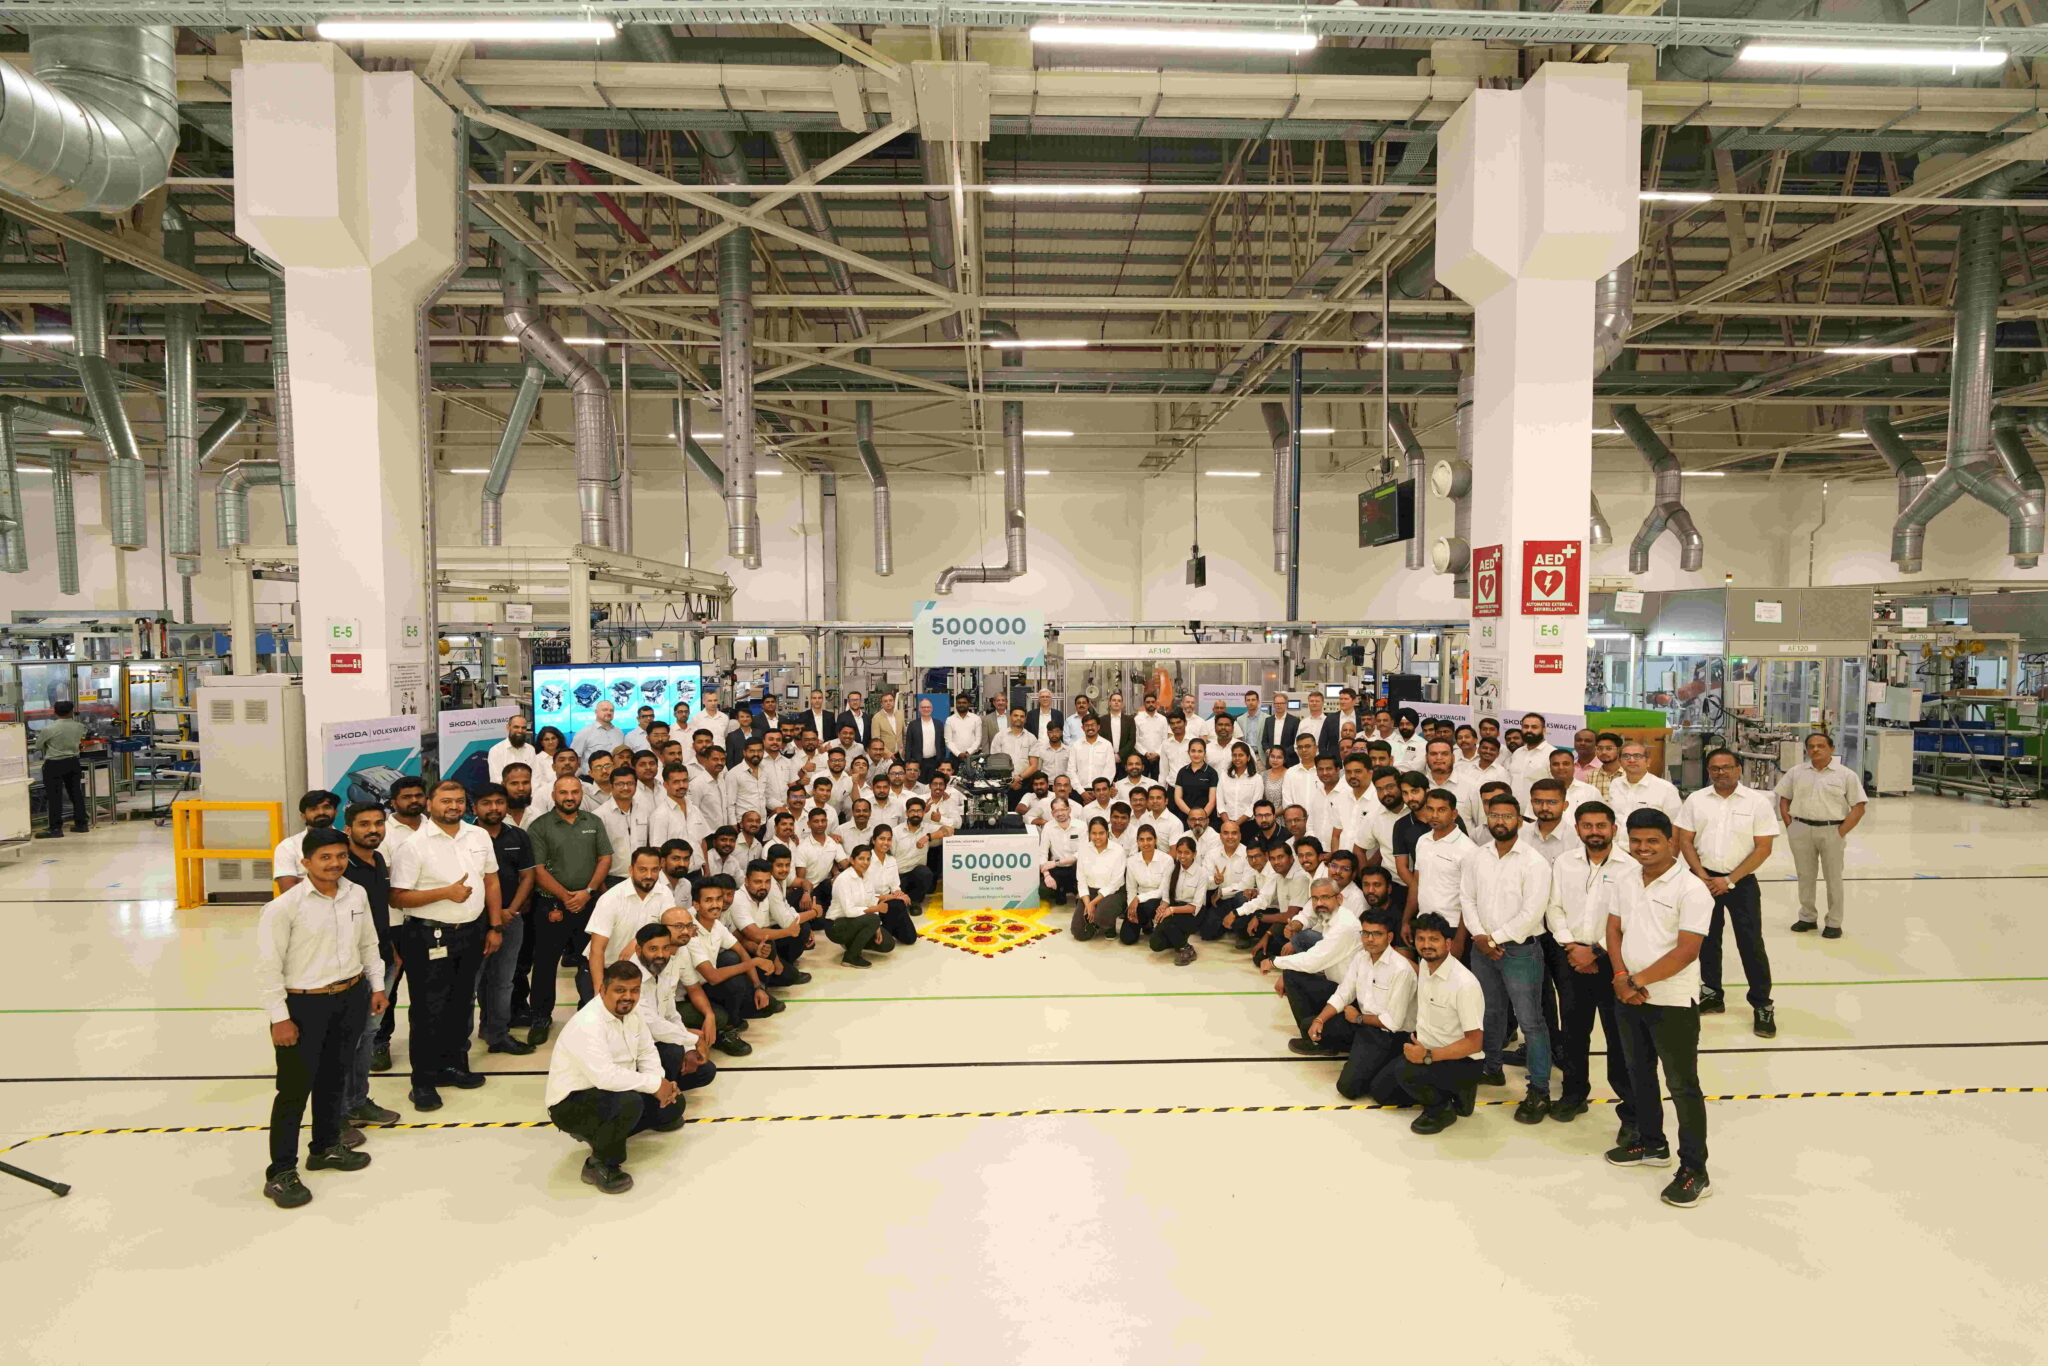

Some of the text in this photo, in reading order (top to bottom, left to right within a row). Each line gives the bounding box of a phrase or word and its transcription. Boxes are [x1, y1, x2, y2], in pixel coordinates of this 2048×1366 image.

[1479, 559, 1495, 571] AED
[1534, 554, 1564, 565] AED
[333, 626, 352, 638] E-5
[406, 626, 418, 637] E-5
[932, 618, 1026, 635] 500000
[1482, 626, 1492, 637] E-6
[1540, 624, 1558, 636] E-6
[942, 638, 976, 647] Engines
[372, 725, 416, 736] VOLKSWAGEN
[1546, 722, 1576, 730] KSWAGEN
[952, 853, 1032, 870] 500000
[971, 873, 1012, 884] Engines
